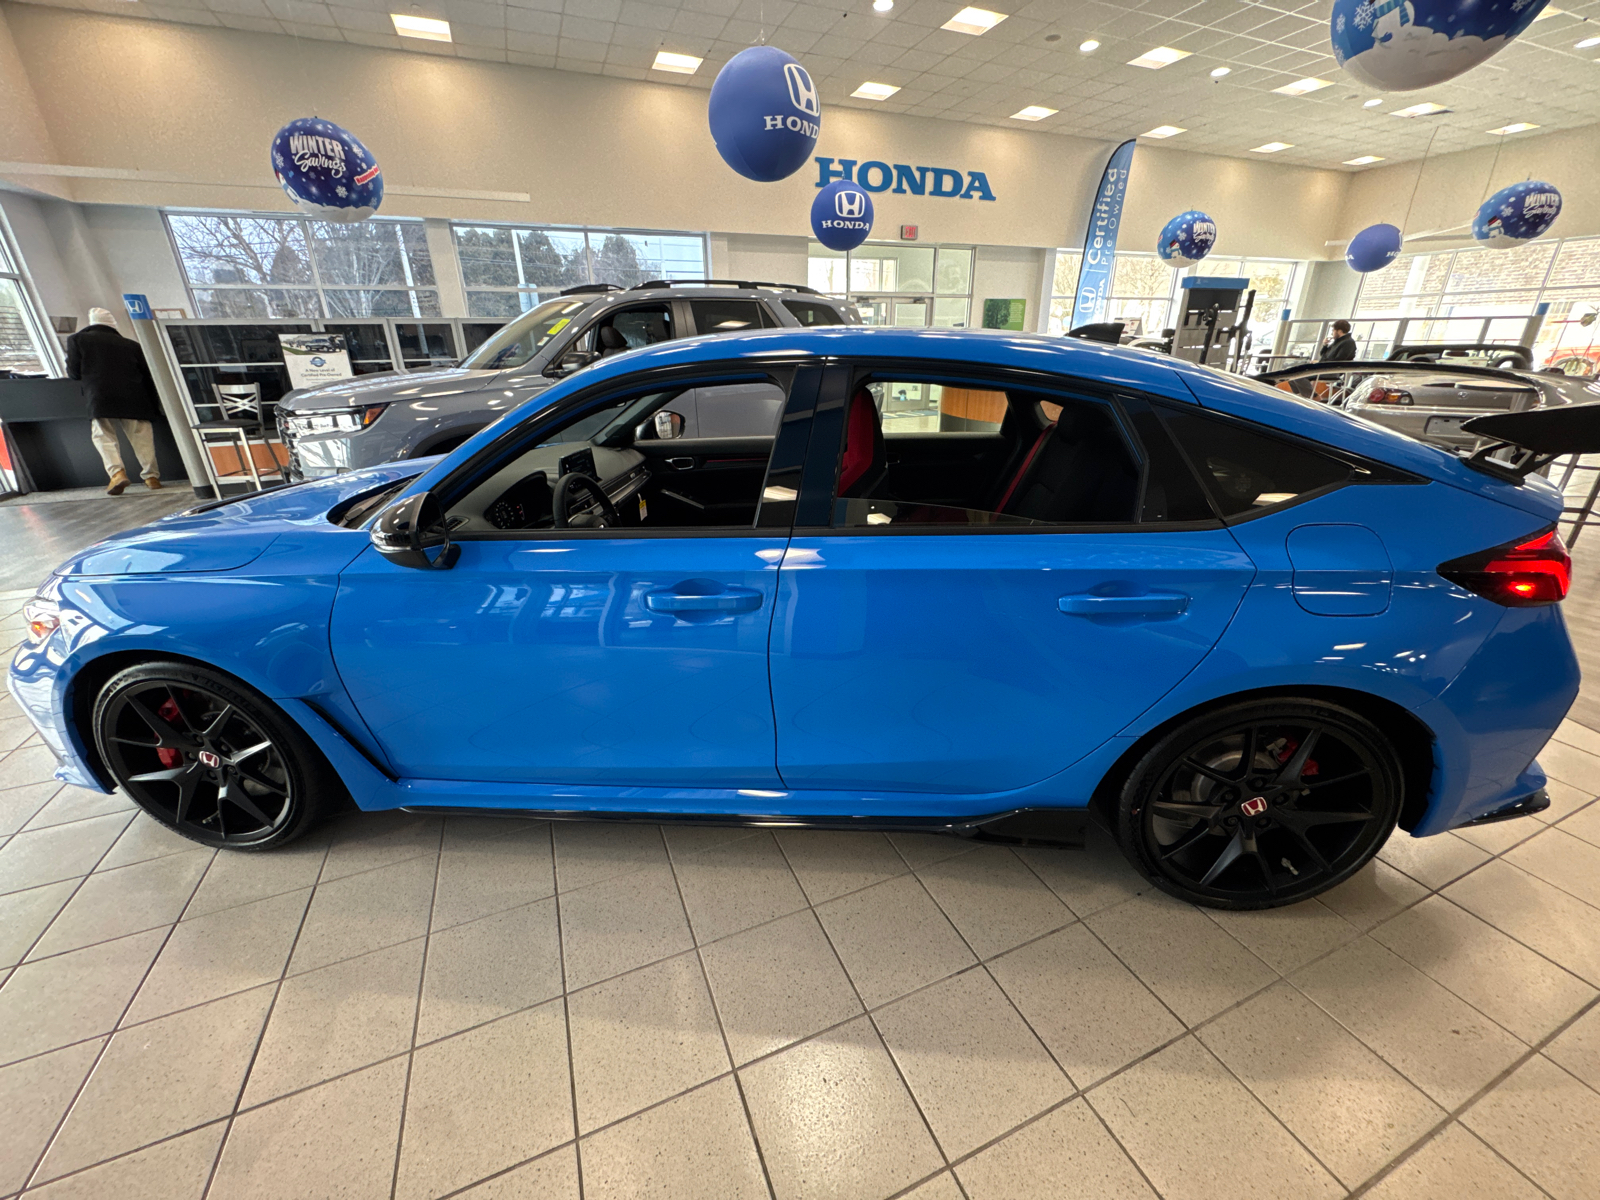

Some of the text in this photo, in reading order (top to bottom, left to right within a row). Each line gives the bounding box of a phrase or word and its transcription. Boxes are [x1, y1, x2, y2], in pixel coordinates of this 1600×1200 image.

[763, 115, 819, 139] HOND
[289, 135, 346, 160] WINTER
[293, 149, 347, 178] Savings
[814, 156, 997, 202] HONDA
[821, 219, 870, 231] HONDA
[1087, 168, 1127, 266] Certified Pre-Owned
[904, 225, 917, 239] EXIT
